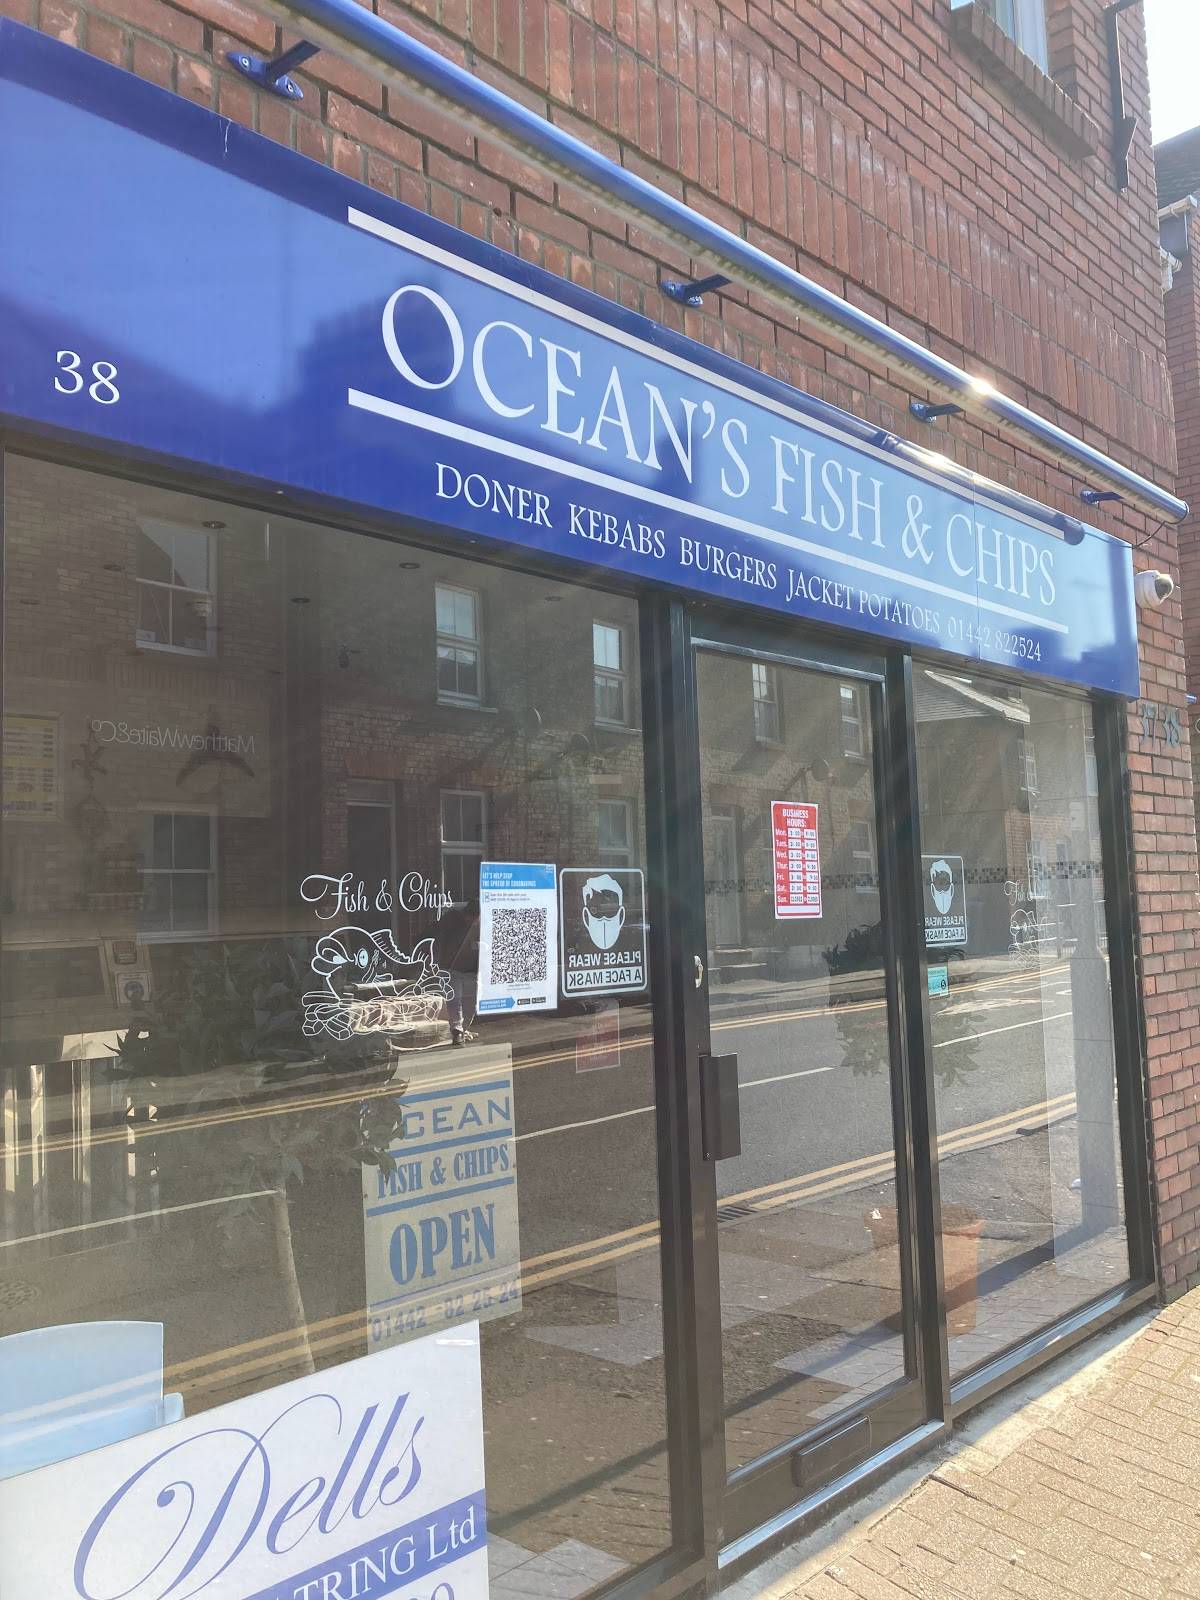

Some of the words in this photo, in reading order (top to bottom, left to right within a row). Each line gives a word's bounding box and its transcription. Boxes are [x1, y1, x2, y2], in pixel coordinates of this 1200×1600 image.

[54, 351, 121, 404] 38
[382, 285, 750, 498] OCEAN'S
[770, 436, 886, 548] FISH
[901, 495, 934, 564] &
[947, 513, 1056, 606] CHIPS
[435, 462, 552, 528] DONER
[568, 503, 666, 558] KEBABS
[680, 536, 777, 589] BURGERS
[786, 568, 853, 610] JACKET
[859, 590, 940, 633] POTATOES
[948, 617, 991, 648] 01442
[994, 631, 1042, 662] 822524
[782, 808, 809, 818] BUSINESS
[300, 872, 369, 920] Fish
[375, 879, 393, 913] &
[399, 871, 454, 921] Chips
[400, 1096, 511, 1140] CEAN
[377, 1160, 423, 1199] FISH
[430, 1157, 446, 1186] &
[453, 1143, 510, 1181] CHIPS
[389, 1202, 496, 1286] OPEN
[371, 1305, 427, 1342] 01442
[74, 1393, 425, 1600] Dells
[426, 1505, 478, 1562] Ltd
